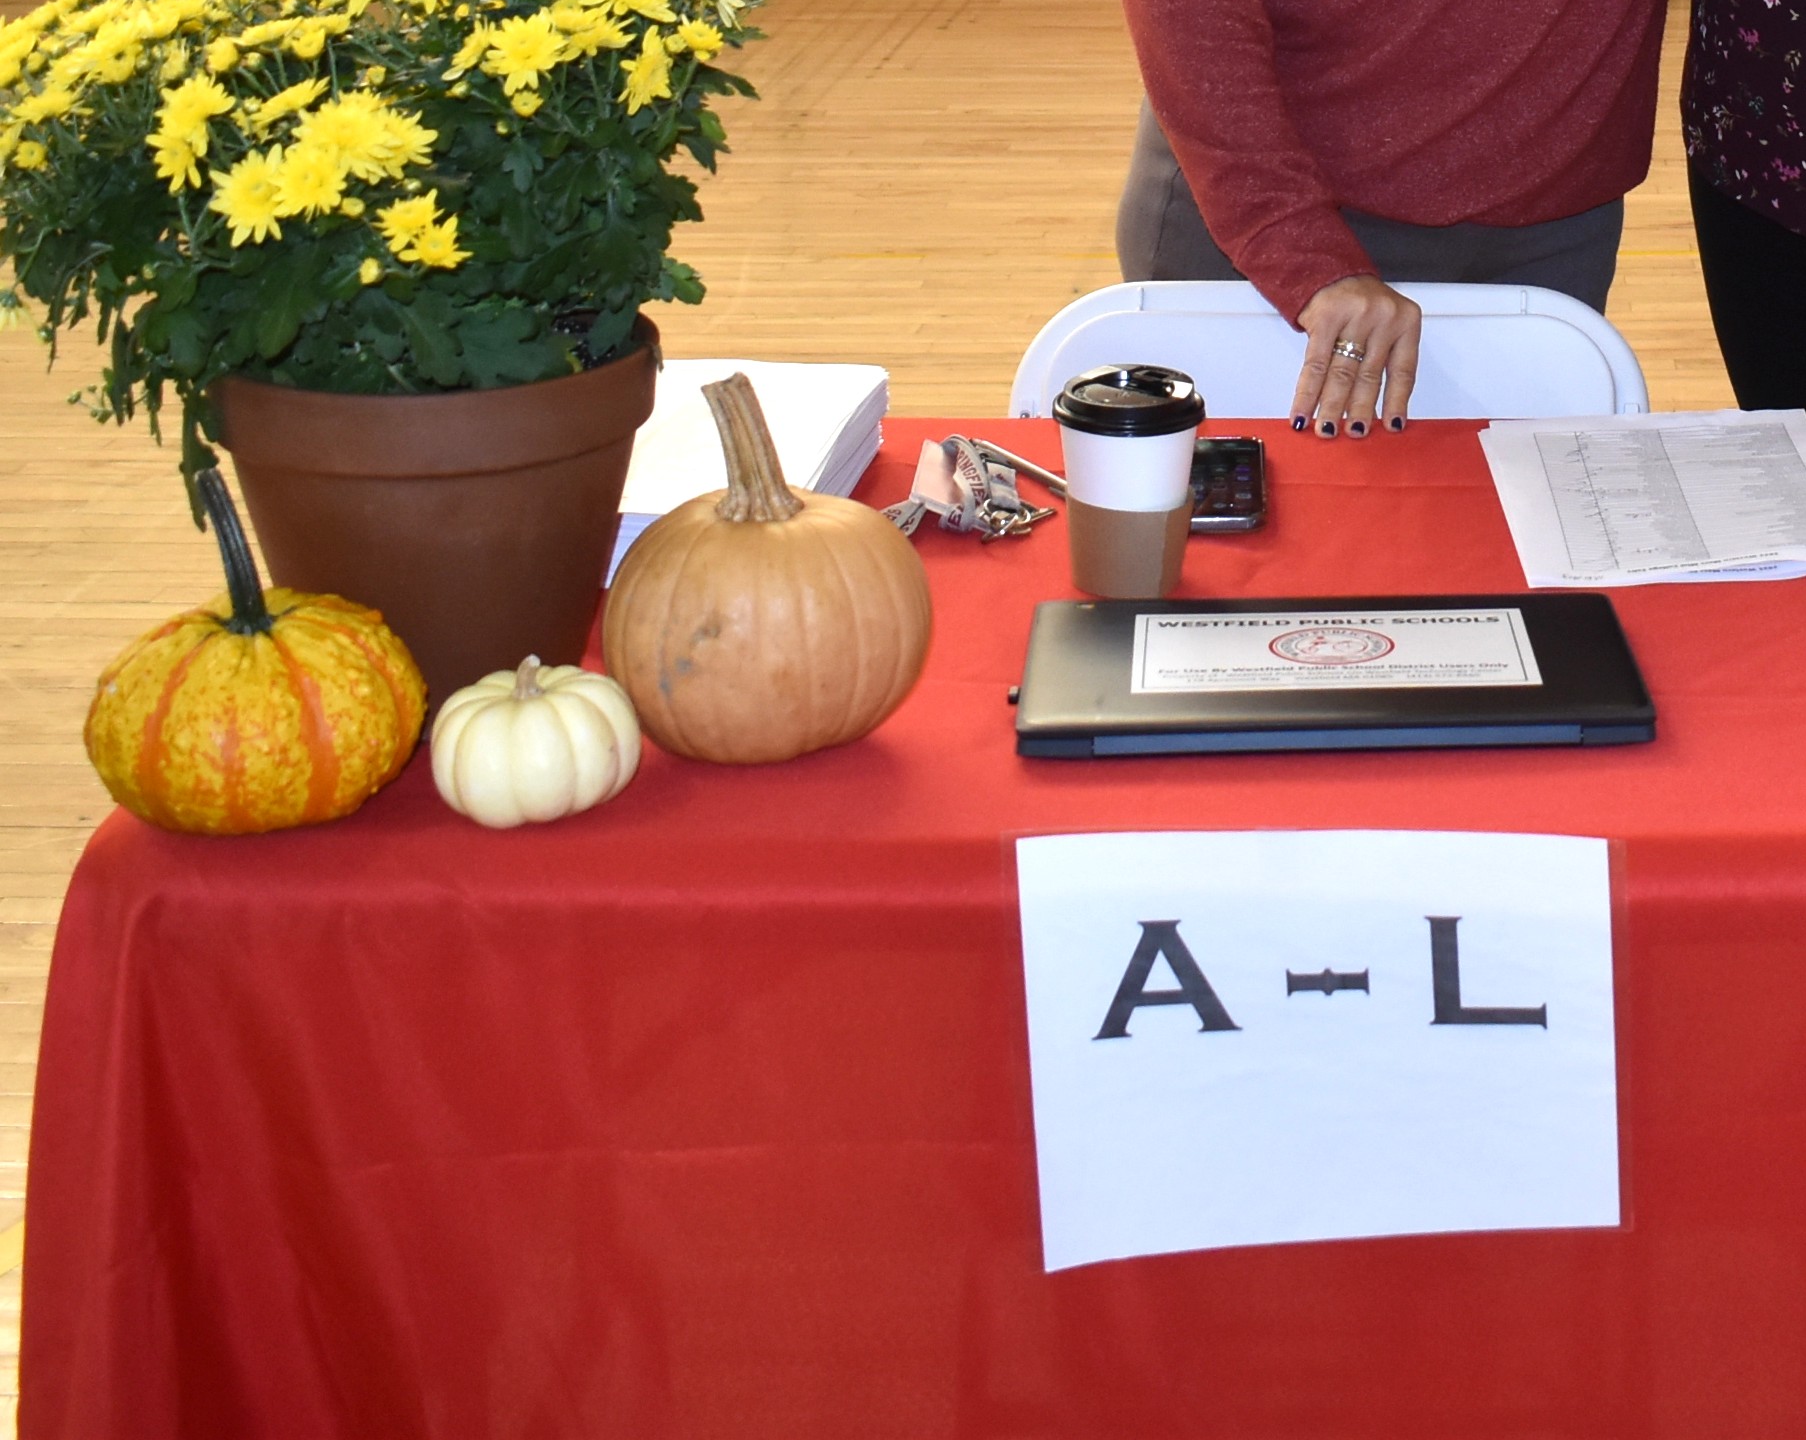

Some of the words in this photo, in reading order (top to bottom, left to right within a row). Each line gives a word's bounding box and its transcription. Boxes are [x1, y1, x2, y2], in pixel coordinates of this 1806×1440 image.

[1158, 619, 1291, 628] WESTFIELD
[1298, 618, 1384, 626] PUBLIC
[1391, 616, 1501, 625] SCHOOLS
[1093, 920, 1242, 1041] A
[1425, 916, 1548, 1030] L
